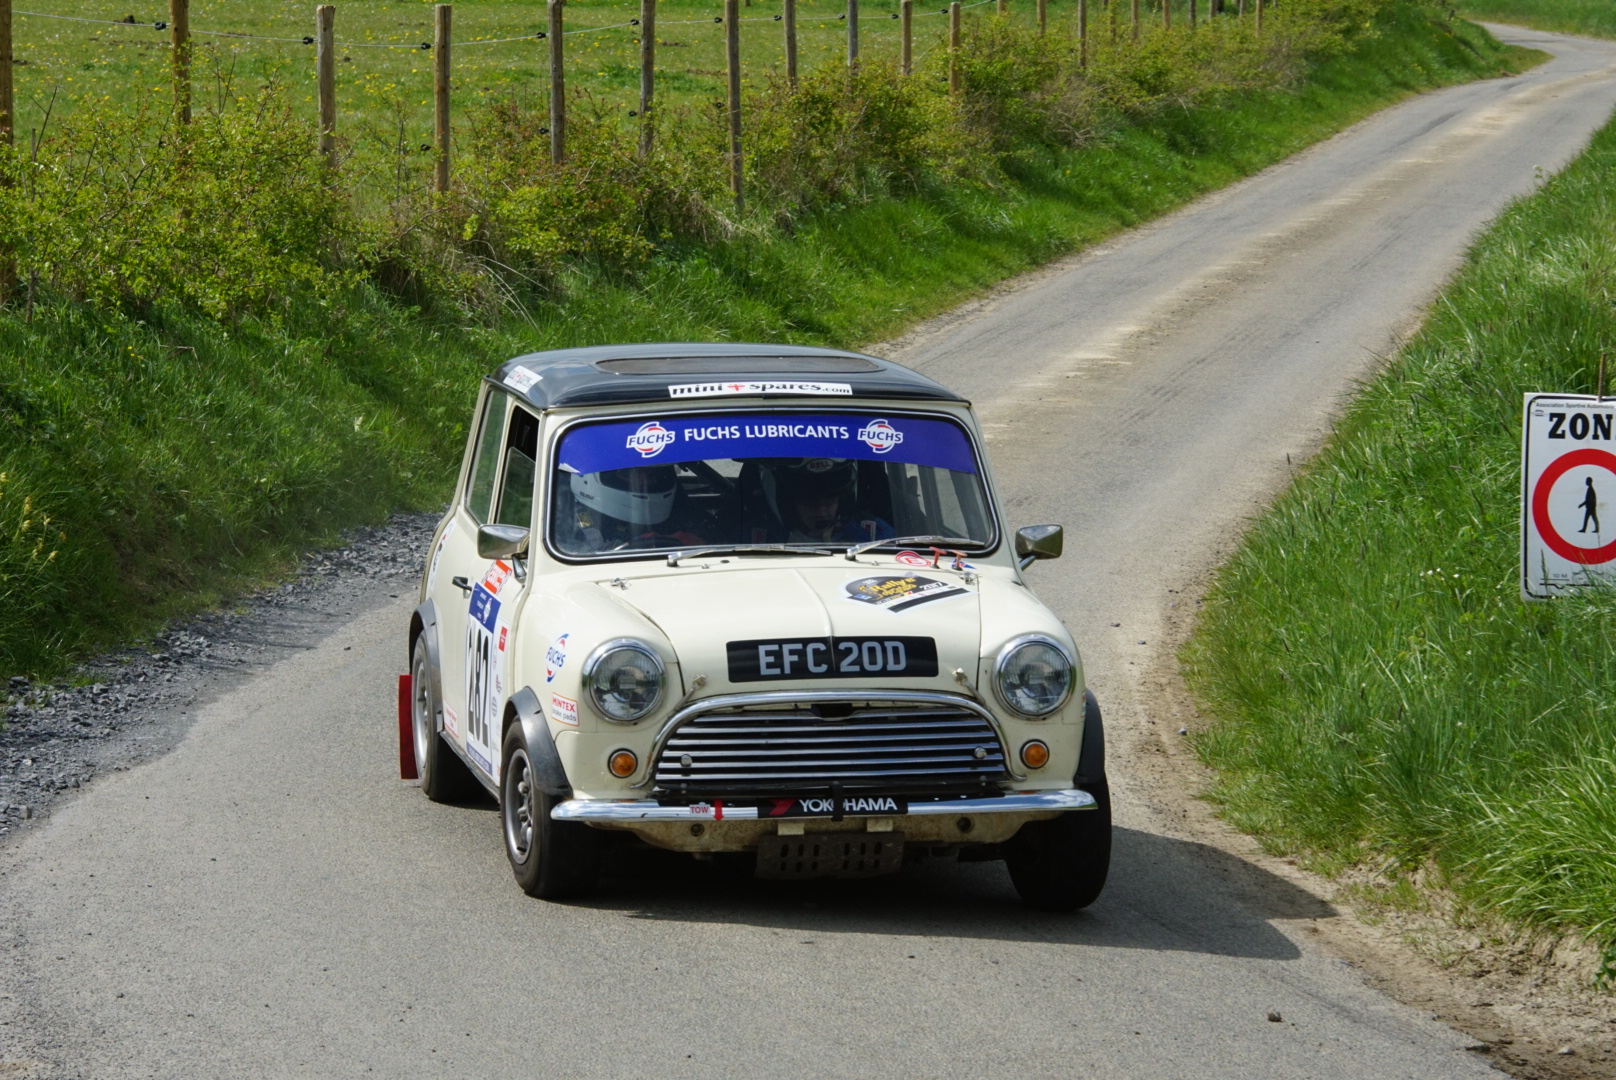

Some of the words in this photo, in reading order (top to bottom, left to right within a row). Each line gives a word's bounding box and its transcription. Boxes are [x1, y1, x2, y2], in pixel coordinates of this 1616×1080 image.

[672, 384, 723, 395] mini
[749, 383, 850, 393] spares.com
[1548, 412, 1616, 440] ZON
[628, 432, 673, 446] FUCHS
[684, 426, 740, 442] FUCHS
[745, 425, 849, 439] LUBRICANTS
[859, 430, 902, 442] FUCHS
[546, 646, 566, 668] FUCHS
[758, 642, 828, 676] EFC
[838, 641, 907, 672] 20D
[552, 697, 576, 713] MINTEX
[562, 712, 577, 722] pads
[690, 805, 709, 814] TOW
[800, 798, 897, 812] YOKHAMA
